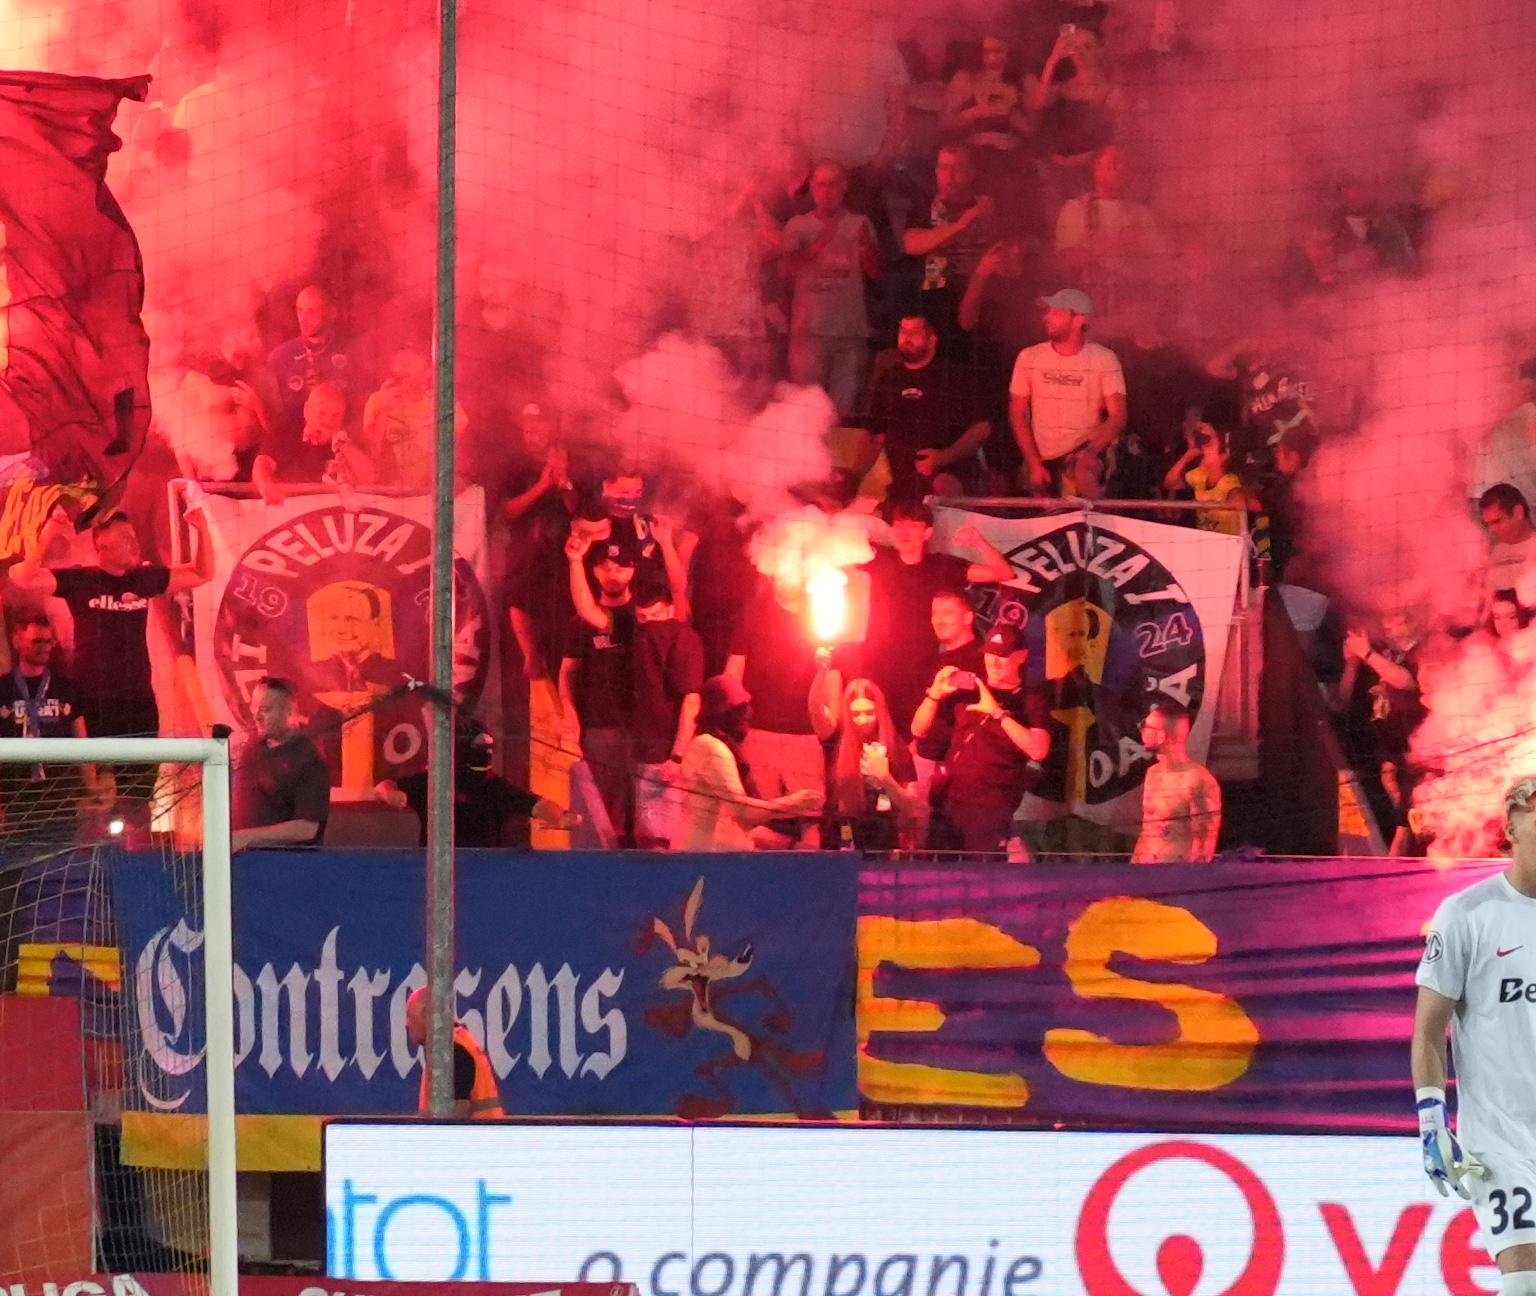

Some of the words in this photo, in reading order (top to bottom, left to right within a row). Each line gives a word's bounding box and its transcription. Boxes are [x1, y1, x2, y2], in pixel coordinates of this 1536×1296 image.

[243, 512, 417, 578] PELUZA
[232, 575, 288, 618] 19
[1135, 612, 1193, 659] 24
[1489, 1186, 1536, 1235] 32
